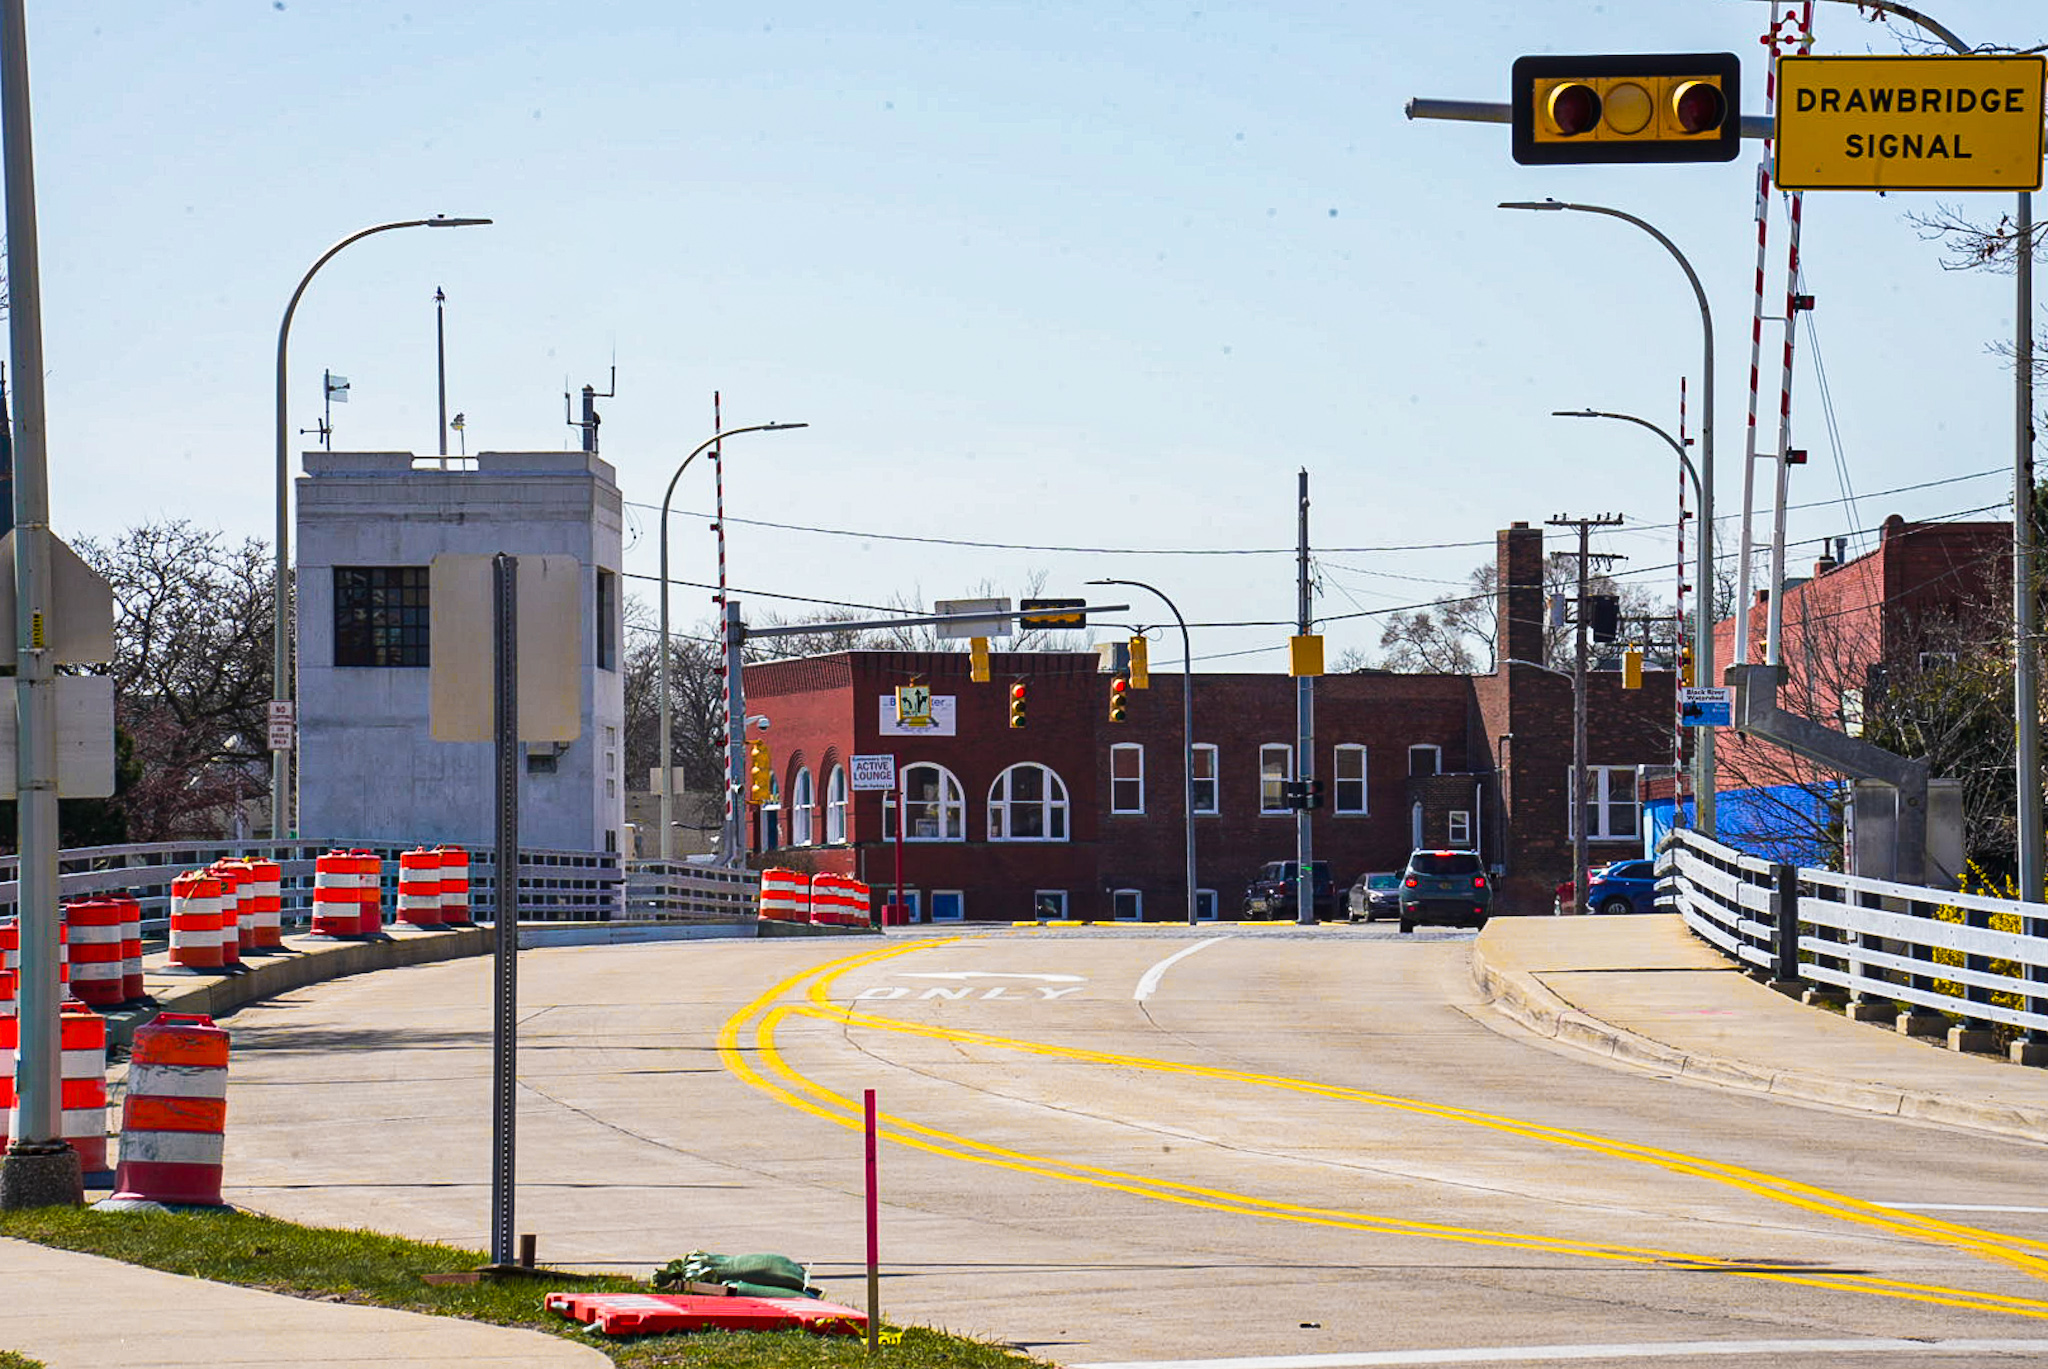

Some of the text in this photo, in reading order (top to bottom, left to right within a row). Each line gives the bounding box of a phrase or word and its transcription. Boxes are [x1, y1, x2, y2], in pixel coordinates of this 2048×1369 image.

[1796, 88, 2024, 112] DRAWBRIDGE
[1845, 134, 1972, 158] SIGNAL
[856, 761, 889, 770] ACTIVE
[854, 771, 892, 780] LOUNGE
[855, 986, 1084, 1000] ONLY
